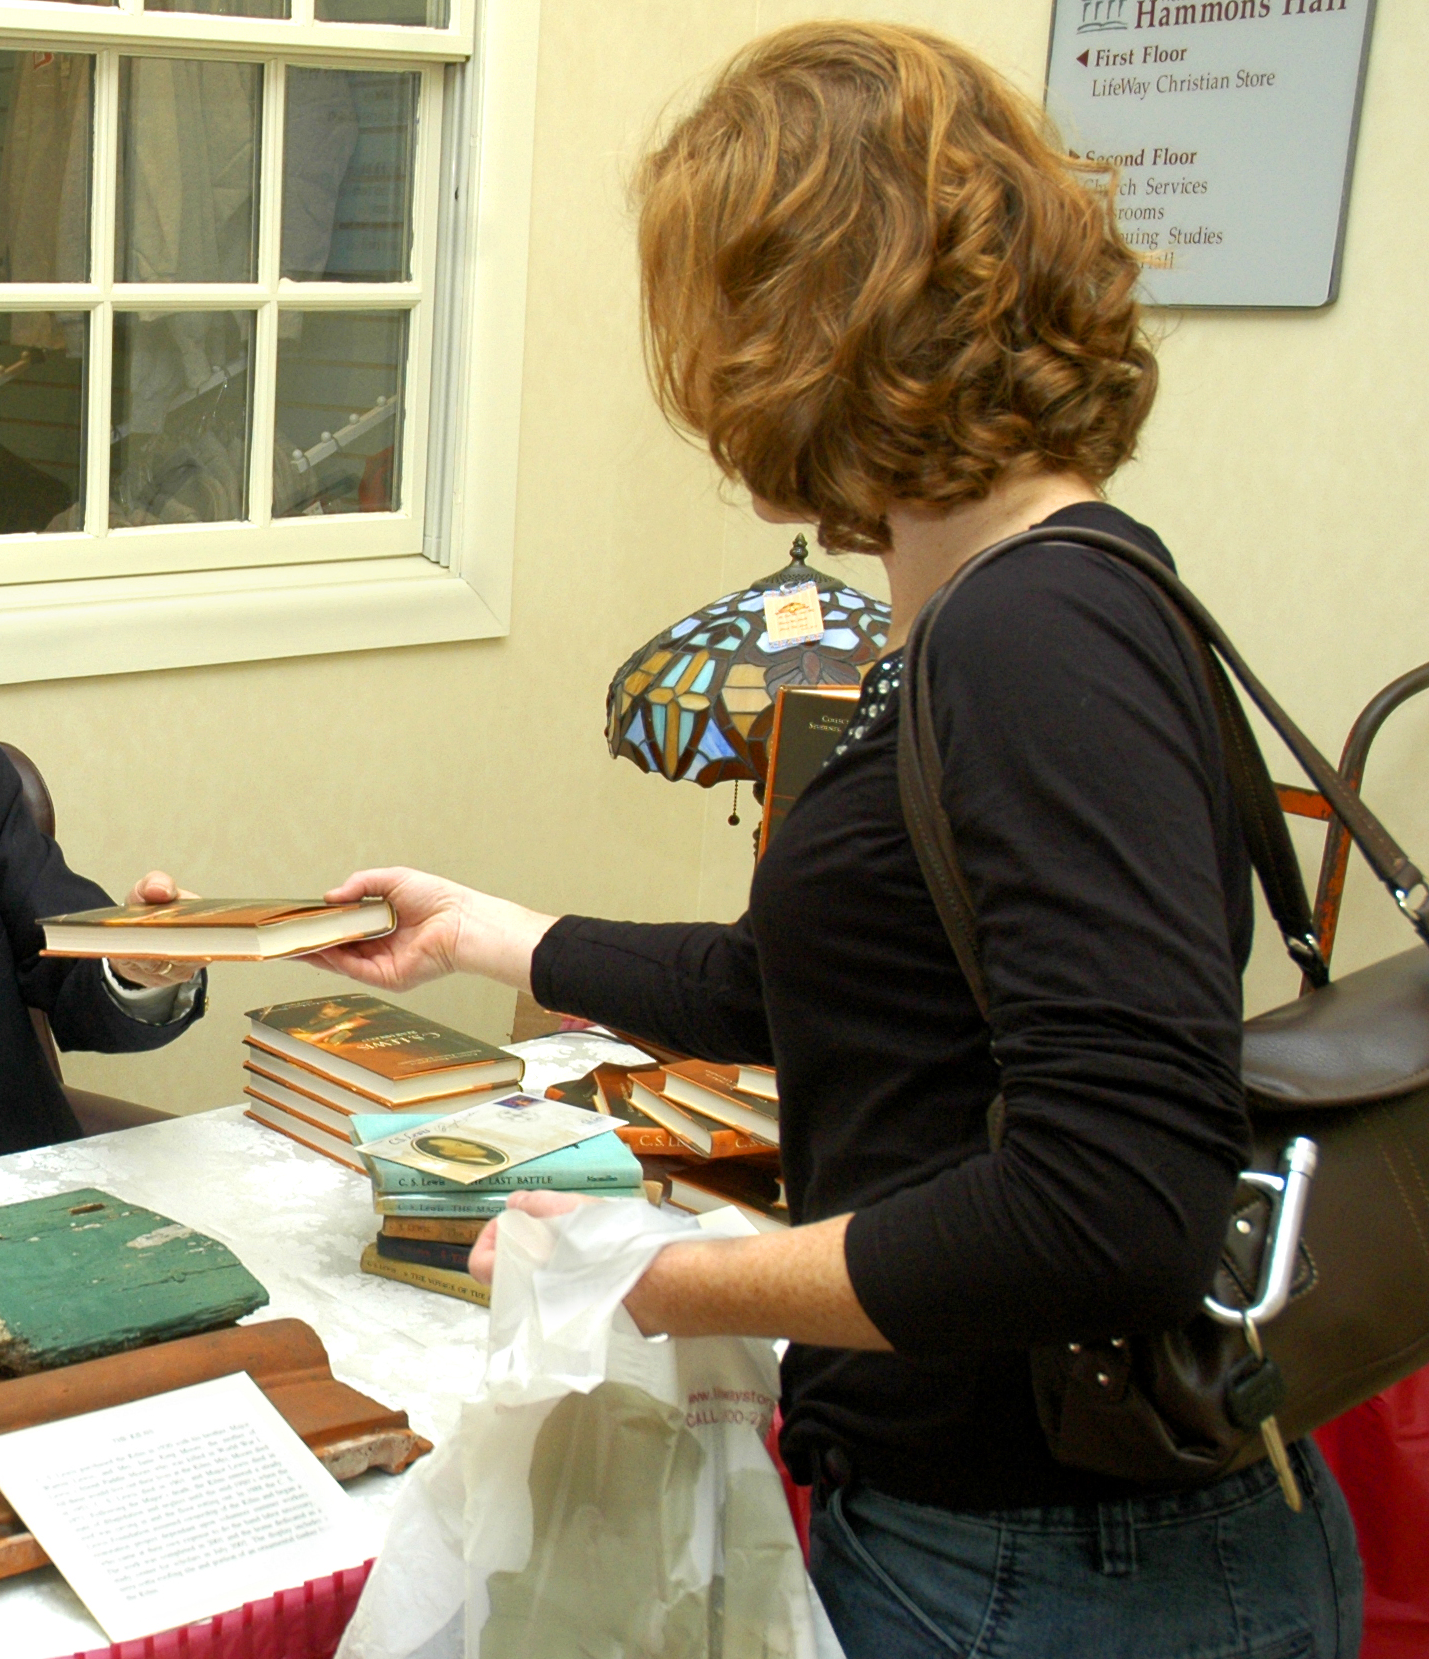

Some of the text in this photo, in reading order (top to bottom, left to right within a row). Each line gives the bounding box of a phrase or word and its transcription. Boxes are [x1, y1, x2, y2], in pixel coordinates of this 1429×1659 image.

[1135, 0, 1271, 29] Hammons
[1094, 45, 1188, 67] First Floor
[1092, 69, 1276, 100] LifeWay Christian Store
[1152, 148, 1198, 166] Floor
[1145, 176, 1209, 196] Services
[1168, 225, 1223, 246] Studies
[421, 1177, 446, 1187] Lewis
[488, 1175, 512, 1186] LAST
[516, 1175, 554, 1185] BATTLE
[410, 1272, 425, 1283] THE
[686, 1410, 718, 1429] CALL
